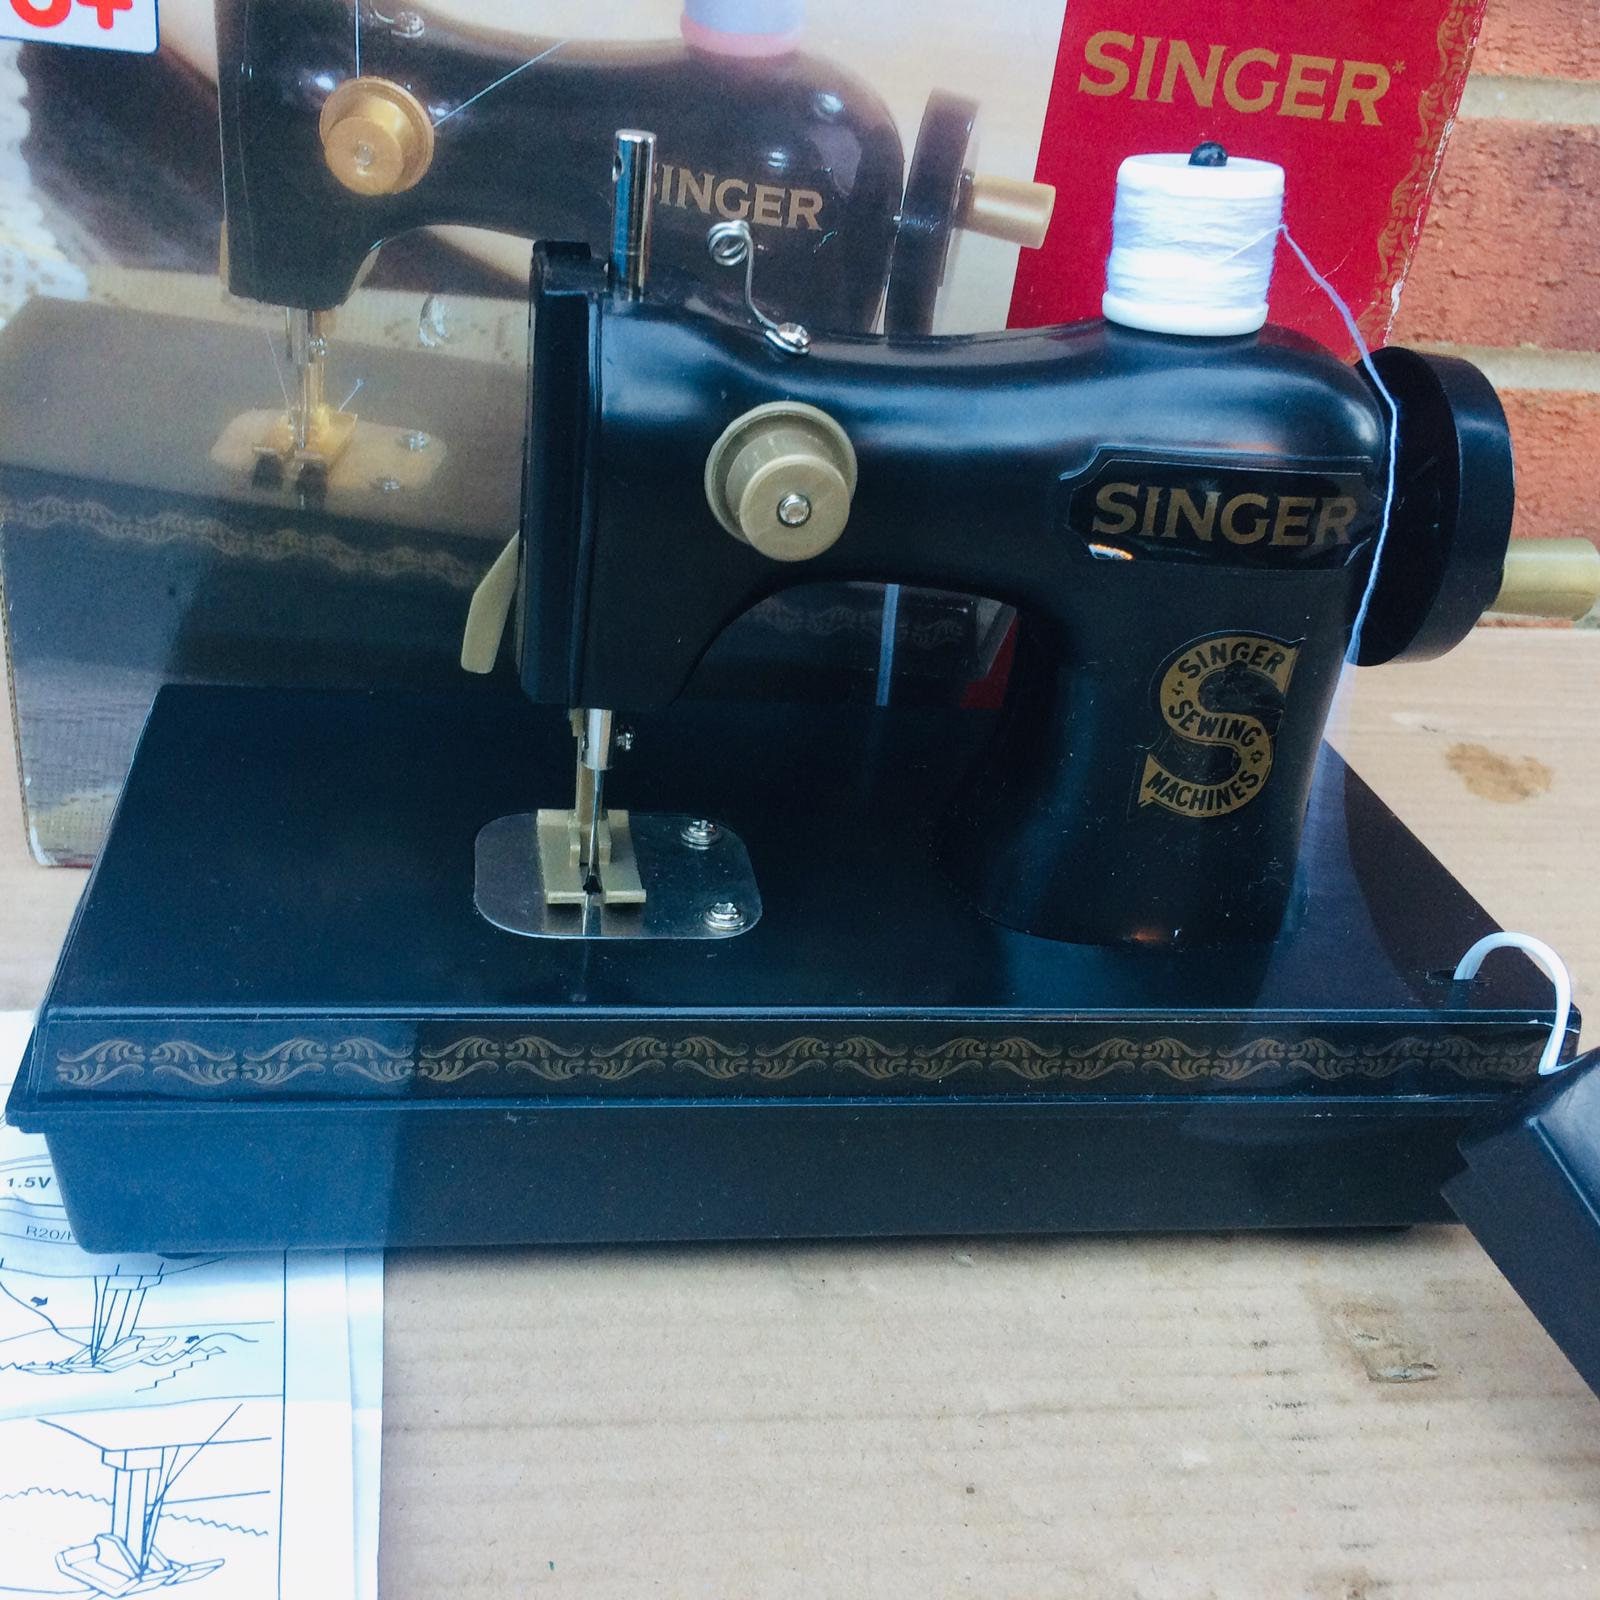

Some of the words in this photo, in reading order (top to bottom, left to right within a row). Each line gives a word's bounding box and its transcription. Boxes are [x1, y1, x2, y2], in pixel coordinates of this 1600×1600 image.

[653, 163, 822, 231] INGER
[1092, 482, 1357, 546] SINGER
[1178, 642, 1286, 680] SINGER
[1168, 699, 1262, 747] SEWING
[1145, 770, 1260, 811] MACHINES
[7, 1177, 51, 1189] 1.5V
